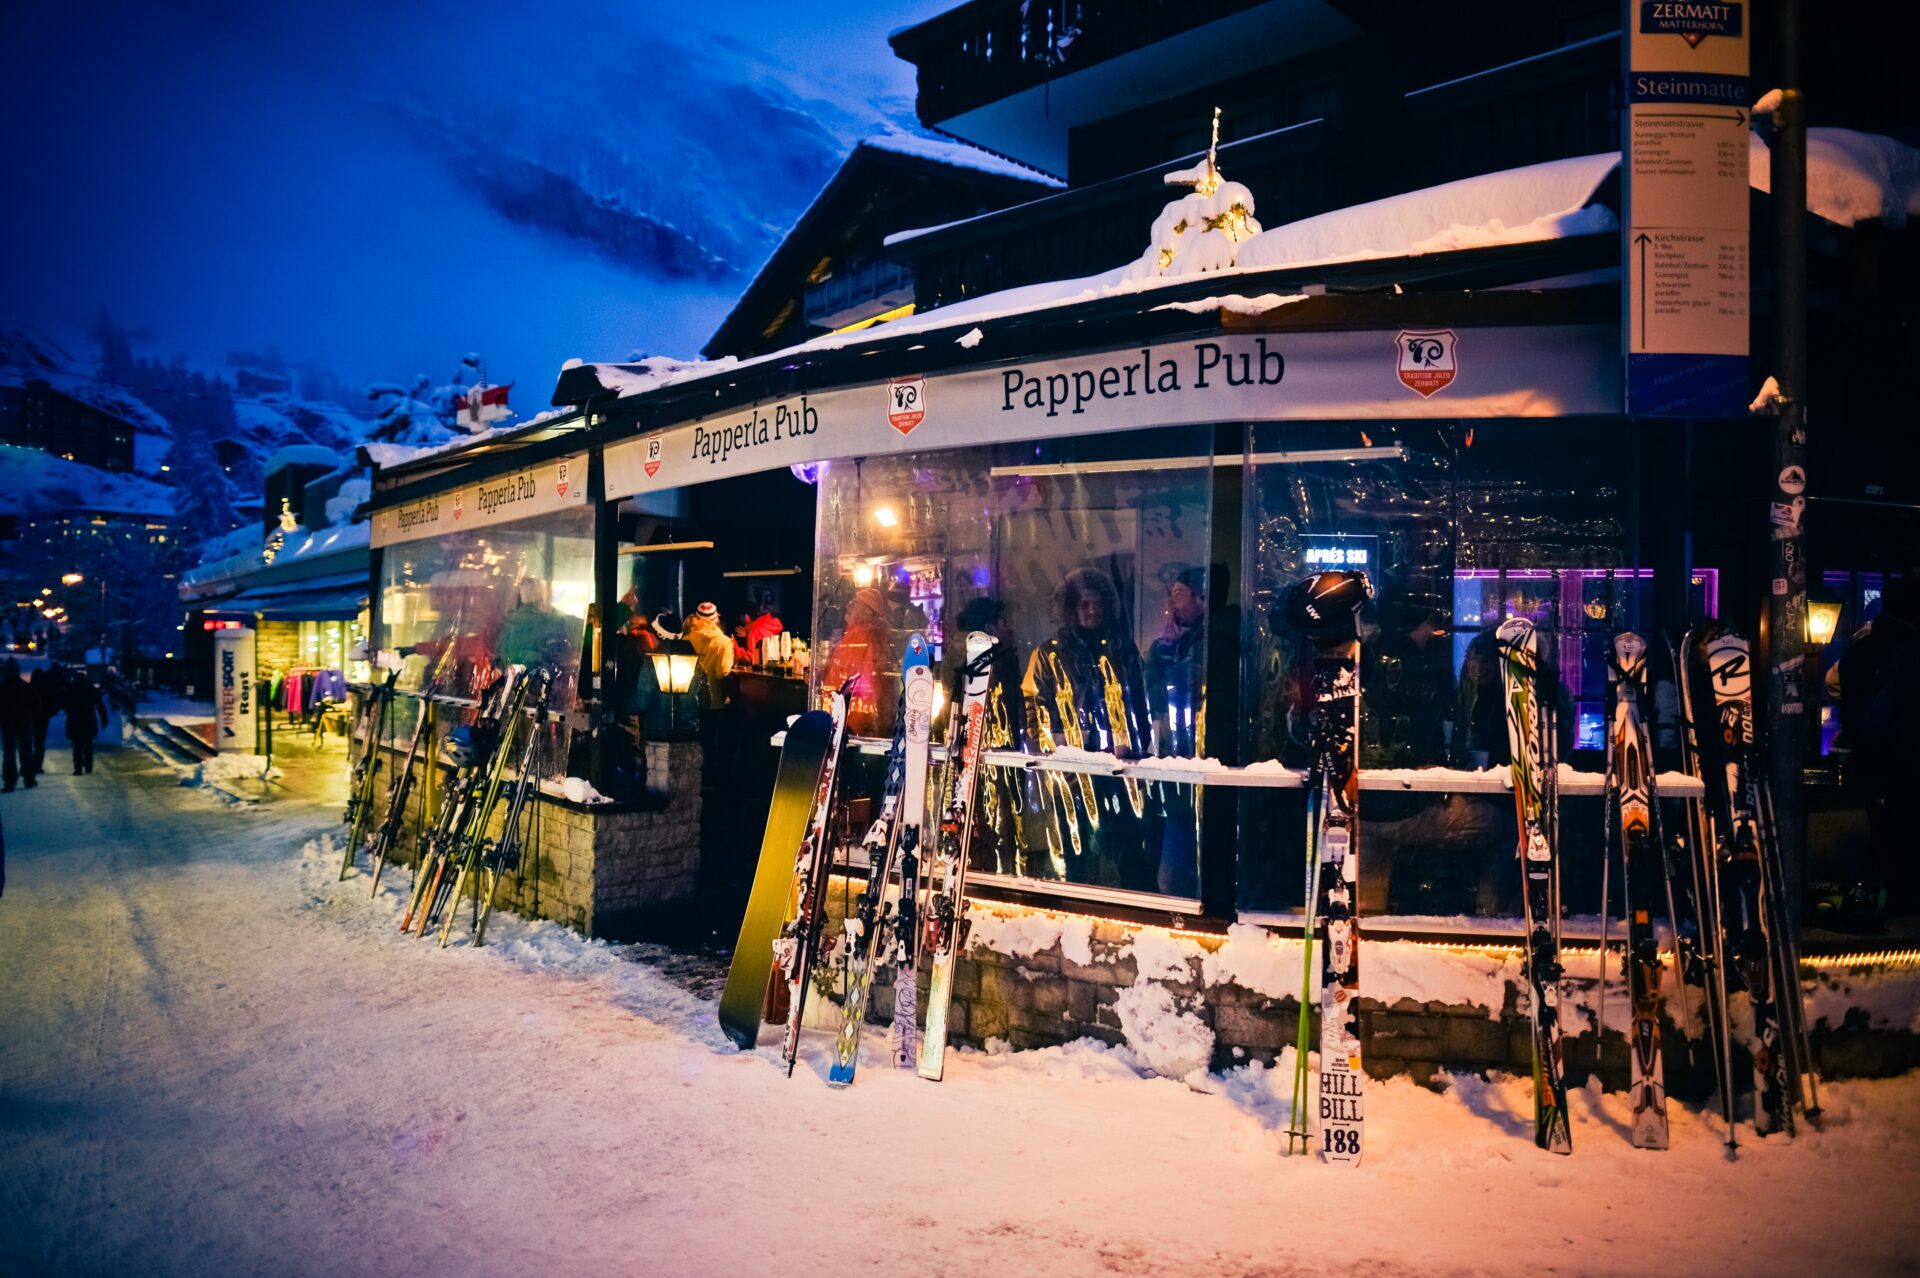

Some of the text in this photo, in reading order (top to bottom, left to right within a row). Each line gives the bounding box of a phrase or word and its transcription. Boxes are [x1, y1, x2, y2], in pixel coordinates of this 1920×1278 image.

[1652, 3, 1730, 21] ZERMATT
[1659, 20, 1725, 31] MATTERHORN
[1636, 77, 1745, 99] Steinmatte
[1634, 120, 1704, 128] Steinmattstrasse
[1654, 233, 1705, 241] Kirchstrasse
[1001, 338, 1286, 417] Papperla Pub
[692, 397, 819, 464] Papperla Pub
[478, 473, 536, 515] Papperla Pub
[397, 500, 440, 533] Papperla Pub
[1346, 549, 1368, 564] SKI
[222, 650, 235, 724] INTERSPORT
[240, 671, 249, 715] Rent
[1325, 751, 1337, 776] SCOTT
[1808, 880, 1841, 893] uvex
[1320, 1072, 1363, 1097] HILL
[1320, 1097, 1364, 1122] BILL
[1323, 1128, 1361, 1155] 188
